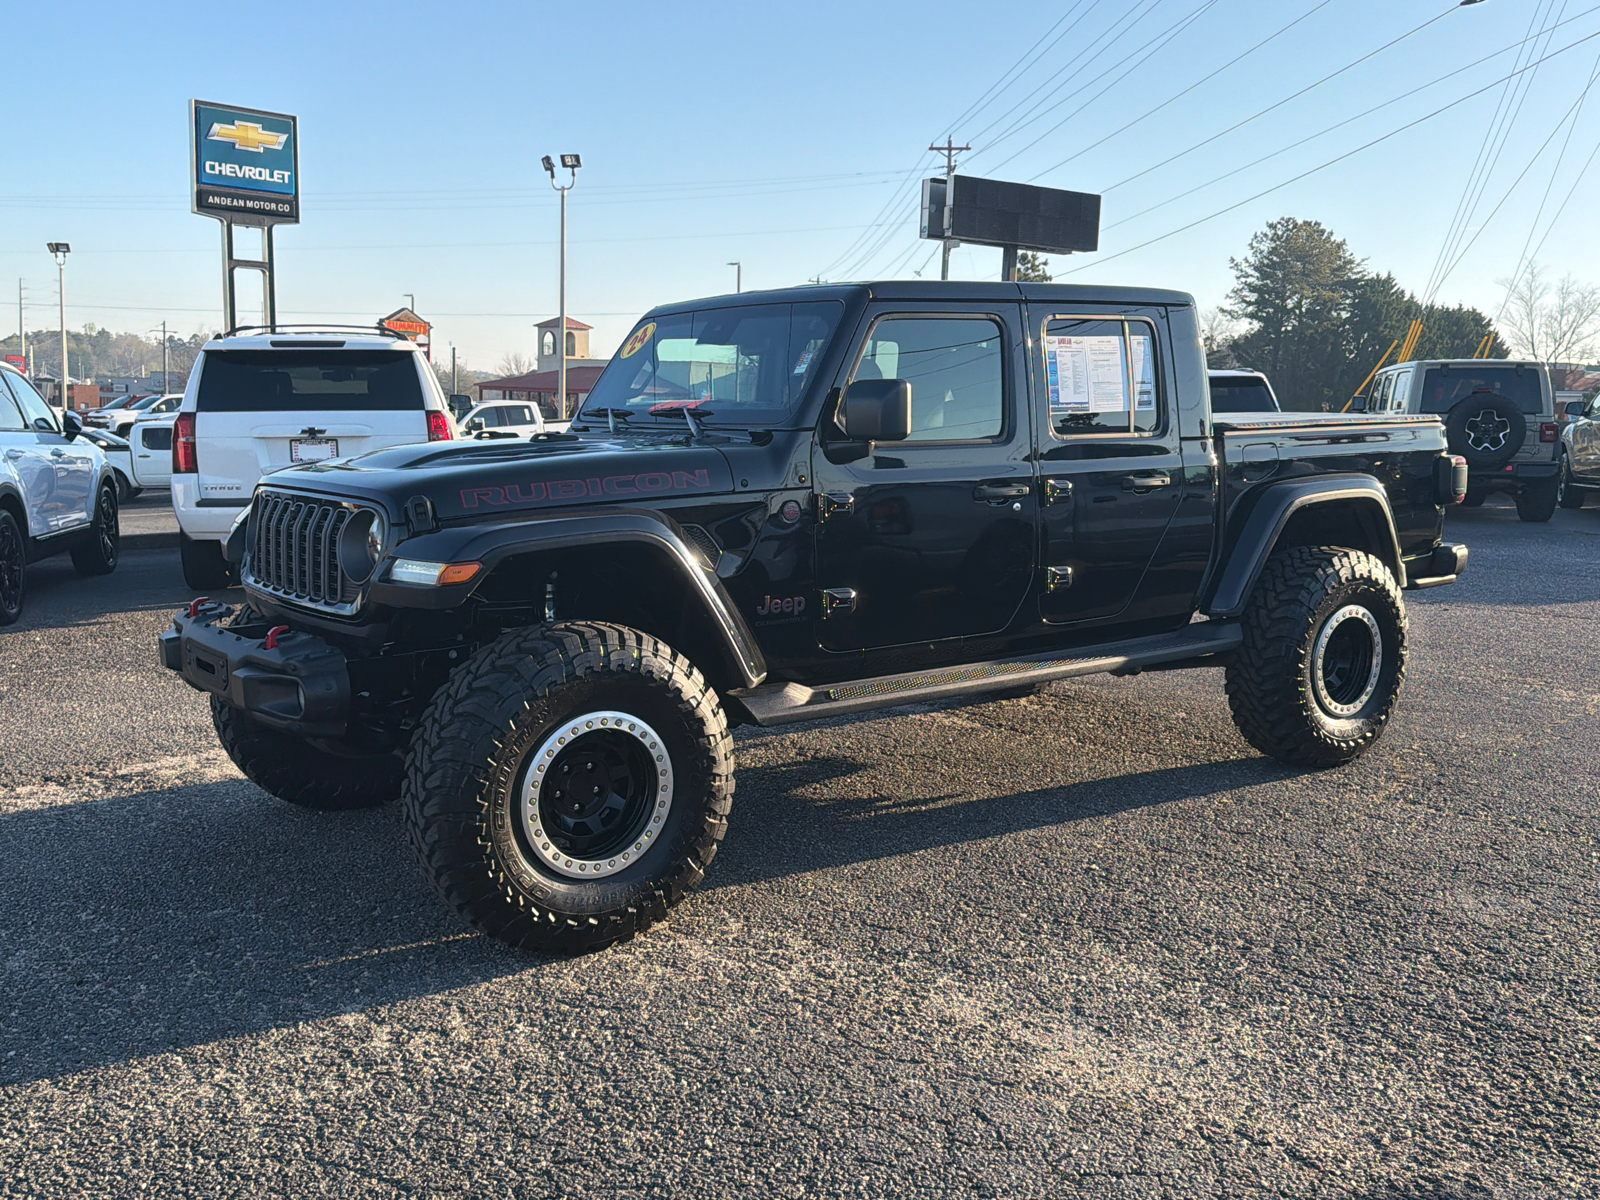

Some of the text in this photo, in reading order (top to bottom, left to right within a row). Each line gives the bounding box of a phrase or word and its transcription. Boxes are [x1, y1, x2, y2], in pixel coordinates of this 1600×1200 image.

[205, 160, 291, 184] CHEVROLET
[208, 195, 290, 212] ANDEAN MOTOR CO
[627, 326, 649, 355] 24
[460, 469, 710, 508] RUBICON
[756, 594, 806, 615] Jeep
